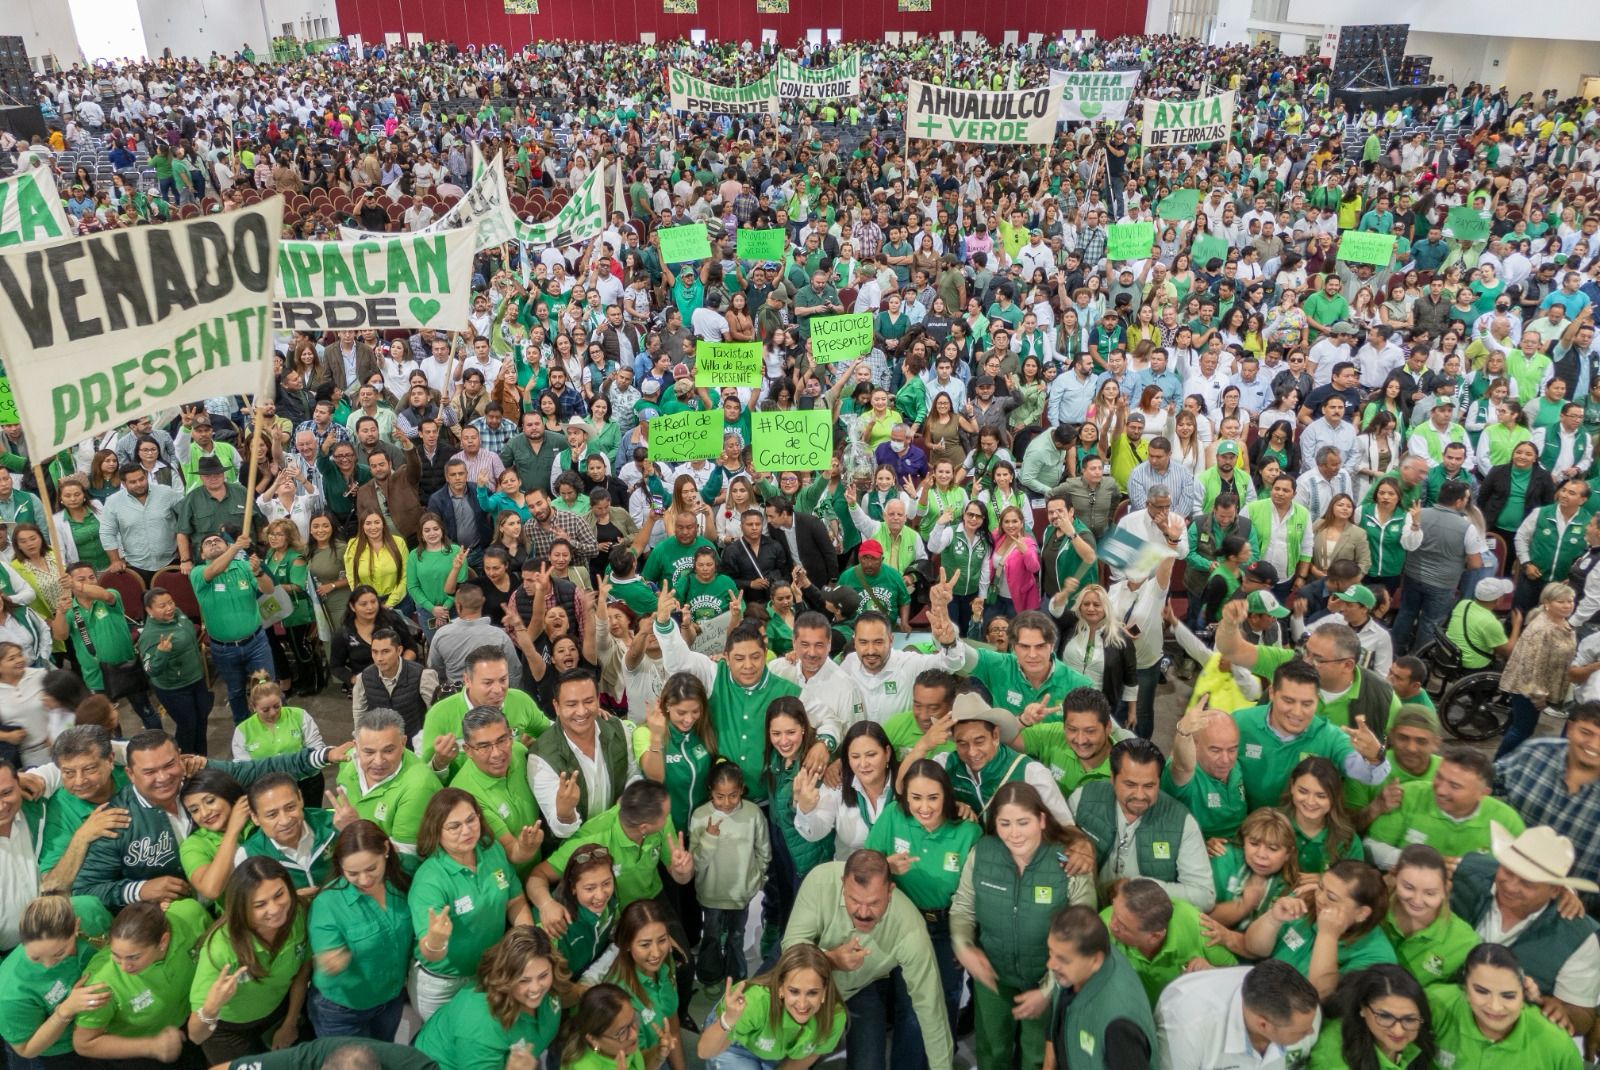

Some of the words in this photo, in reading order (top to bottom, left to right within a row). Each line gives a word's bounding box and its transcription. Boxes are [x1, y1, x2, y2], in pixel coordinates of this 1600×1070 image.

[779, 54, 793, 80] EL
[1066, 73, 1122, 86] AXTLA
[780, 81, 800, 97] CON
[803, 82, 815, 97] EL
[817, 80, 851, 98] VERDE
[687, 98, 769, 113] PRESENTE
[917, 85, 1050, 119] AHUALULCO
[1154, 96, 1223, 129] AXTLA
[948, 119, 1029, 142] VERDE
[1151, 130, 1168, 145] DE
[1171, 124, 1226, 144] TERRAZAS
[0, 212, 271, 349] VENADO
[813, 316, 871, 335] #Catorce
[817, 333, 871, 352] Presente
[709, 346, 753, 359] Taxistas
[701, 359, 720, 370] Villa
[723, 360, 733, 370] de
[711, 372, 752, 384] PRESENTE
[652, 414, 689, 431] #Real
[695, 414, 711, 426] de
[757, 414, 808, 433] #Real
[785, 437, 801, 449] de
[760, 449, 820, 466] Catorce
[858, 586, 892, 599] TAISTAS
